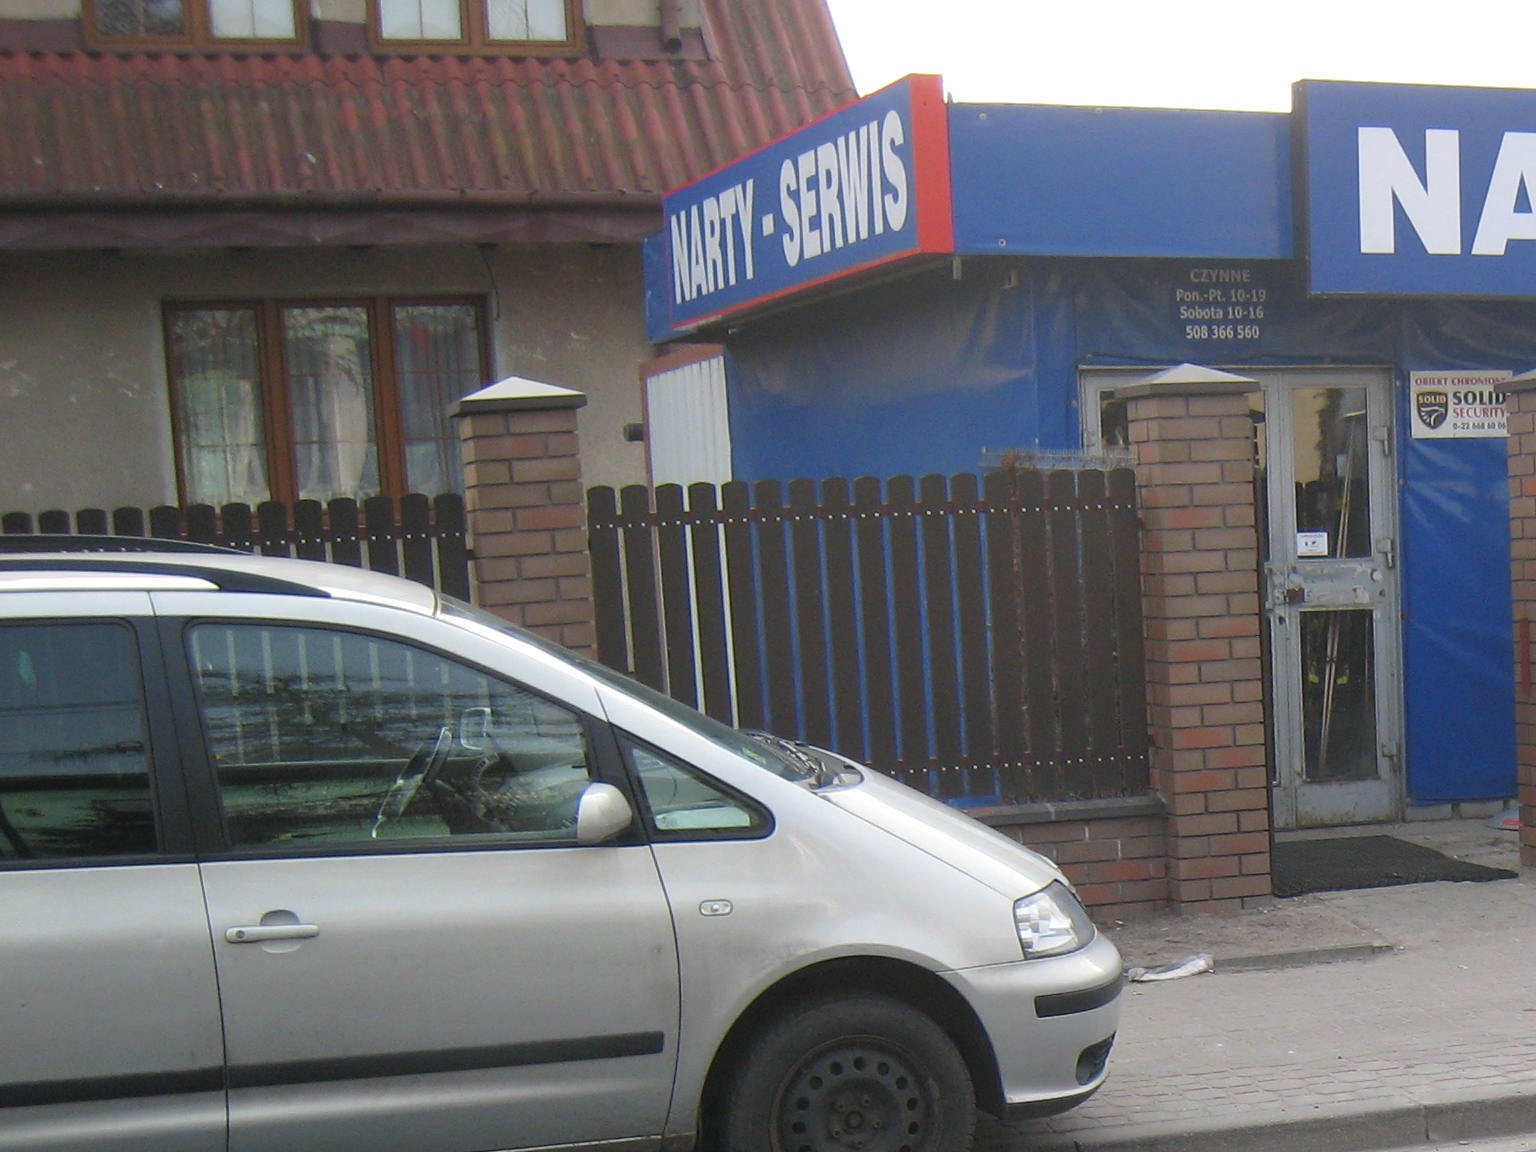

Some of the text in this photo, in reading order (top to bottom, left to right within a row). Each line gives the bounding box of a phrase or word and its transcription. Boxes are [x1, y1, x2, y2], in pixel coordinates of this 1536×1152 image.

[671, 178, 755, 305] NARTY
[779, 109, 909, 267] SERWIS
[1190, 269, 1251, 282] CZYNNE
[1230, 289, 1267, 302] 10-19
[1180, 305, 1264, 319] Sobota 10-16
[1185, 325, 1260, 339] 508 366 560
[1418, 395, 1446, 404] SOLID
[1452, 391, 1506, 405] SOLID
[1452, 407, 1505, 418] SECURITY
